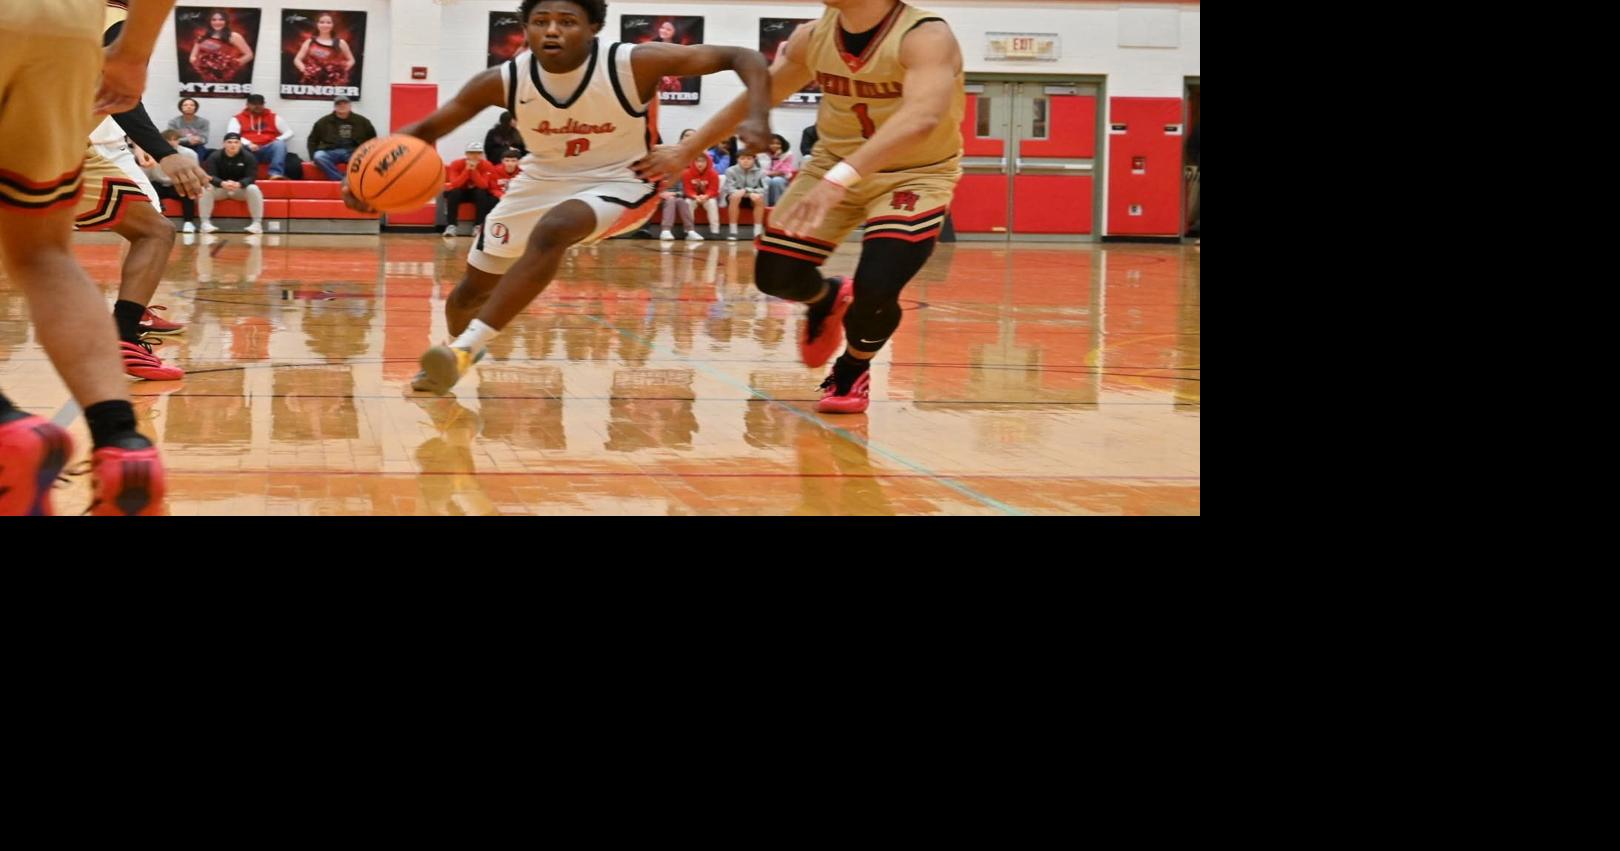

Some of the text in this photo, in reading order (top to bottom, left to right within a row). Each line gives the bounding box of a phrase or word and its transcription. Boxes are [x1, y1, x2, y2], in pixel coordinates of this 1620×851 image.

[1013, 37, 1034, 51] EXIT
[179, 81, 254, 93] MYERS
[281, 84, 360, 96] HUNGER
[531, 117, 616, 136] Indiana
[851, 102, 876, 140] 1
